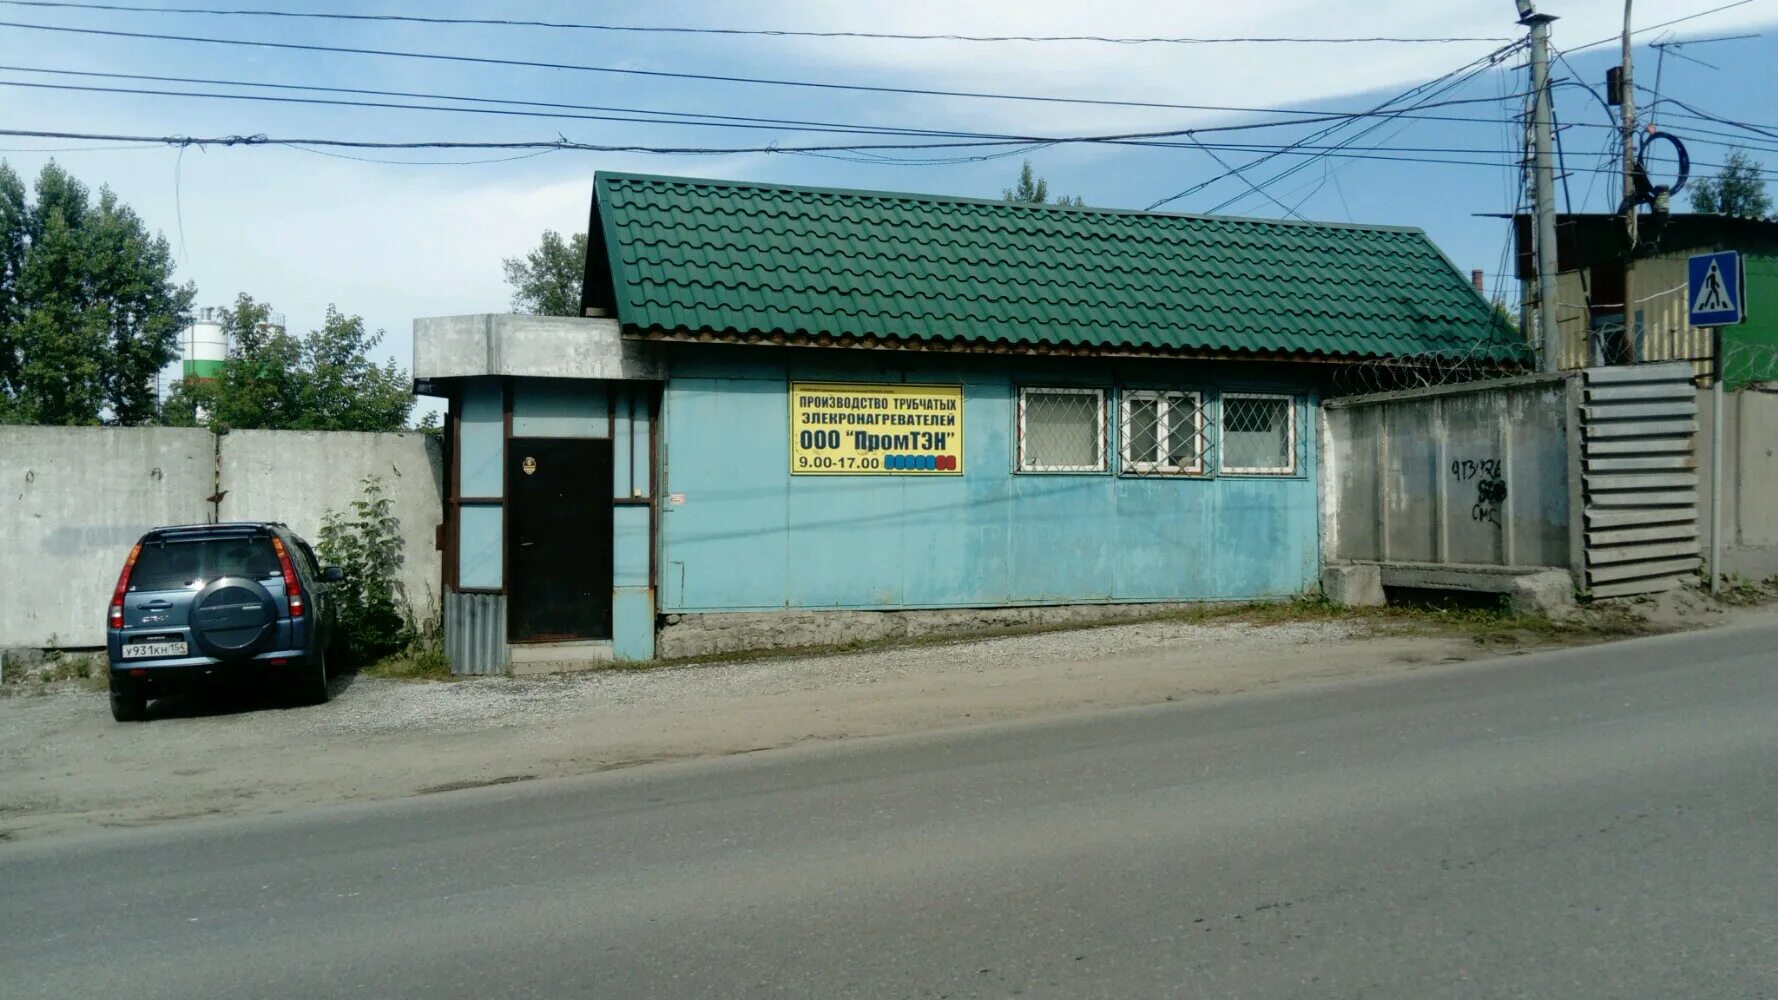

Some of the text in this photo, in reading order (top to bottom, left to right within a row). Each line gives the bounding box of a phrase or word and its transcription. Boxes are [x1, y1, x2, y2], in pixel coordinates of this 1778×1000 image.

[799, 396, 957, 411] ПРОИЗВОДСТВО ТРУБЧАТЫХ
[801, 412, 955, 426] ЭЛЕКРОНАГРЕВАТЕЛЕЙ
[800, 429, 841, 450] ООО
[799, 456, 880, 469] 9.00-17.00
